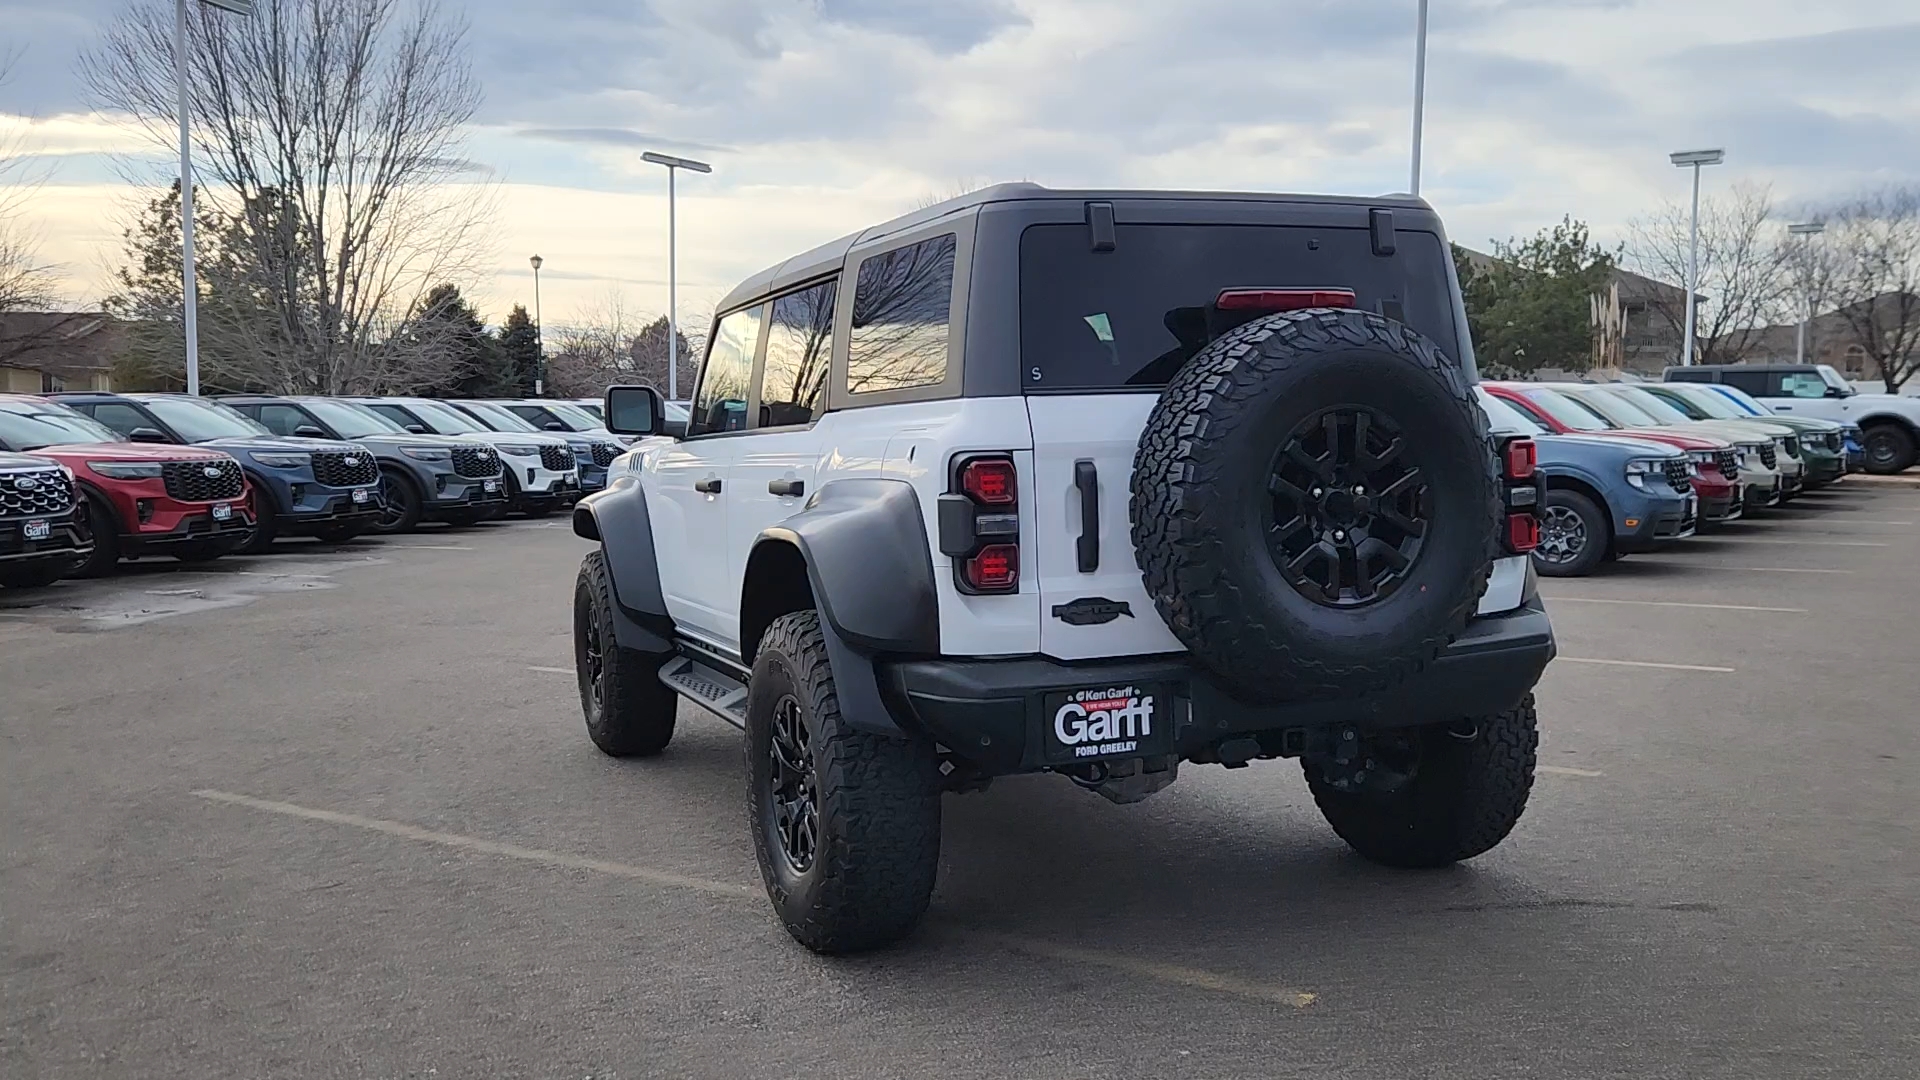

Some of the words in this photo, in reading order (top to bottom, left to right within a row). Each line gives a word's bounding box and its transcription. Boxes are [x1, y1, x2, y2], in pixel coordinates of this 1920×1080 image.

[1031, 367, 1042, 381] S
[212, 505, 231, 519] Garff
[24, 521, 50, 537] Garff
[1086, 690, 1106, 701] Ken
[1107, 686, 1133, 699] Garff
[1054, 696, 1153, 745] Garff
[1075, 745, 1098, 757] FORD
[1099, 741, 1137, 754] GREELEY
